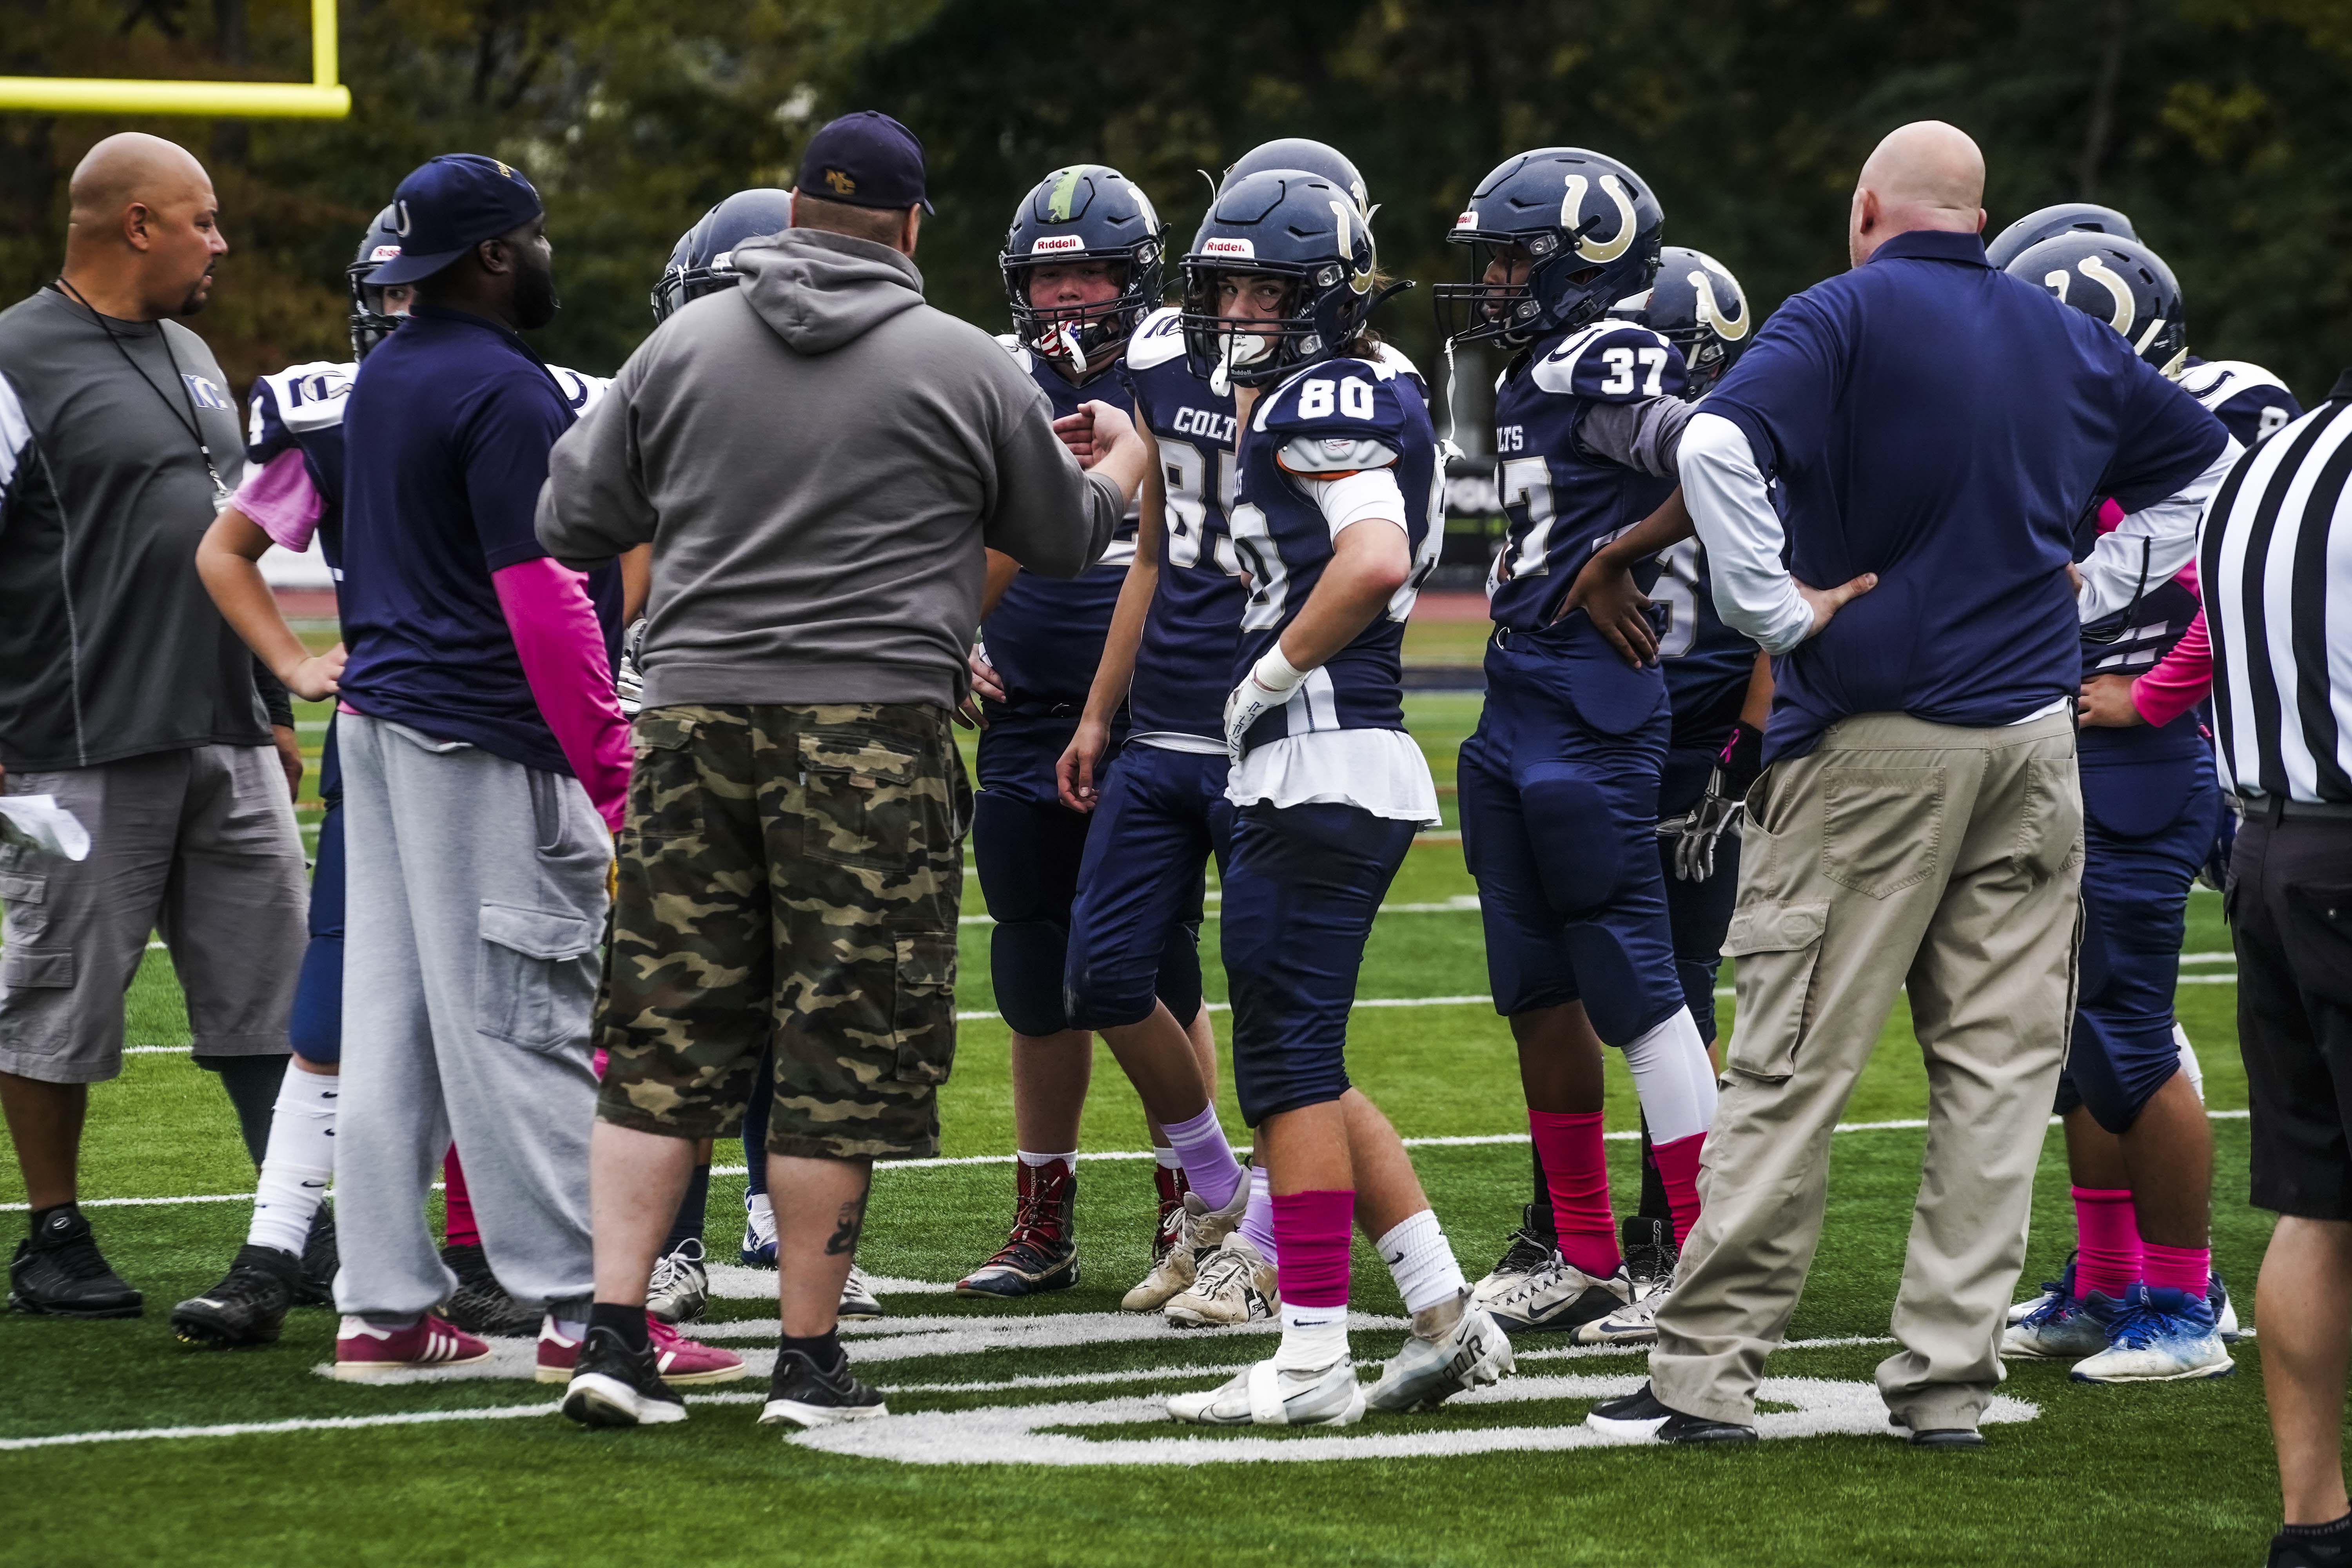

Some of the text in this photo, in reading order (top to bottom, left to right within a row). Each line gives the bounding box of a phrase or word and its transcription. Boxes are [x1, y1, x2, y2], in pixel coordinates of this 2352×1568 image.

[1038, 238, 1076, 249] Riddell
[1601, 347, 1668, 397] 37
[1298, 376, 1374, 421] 80
